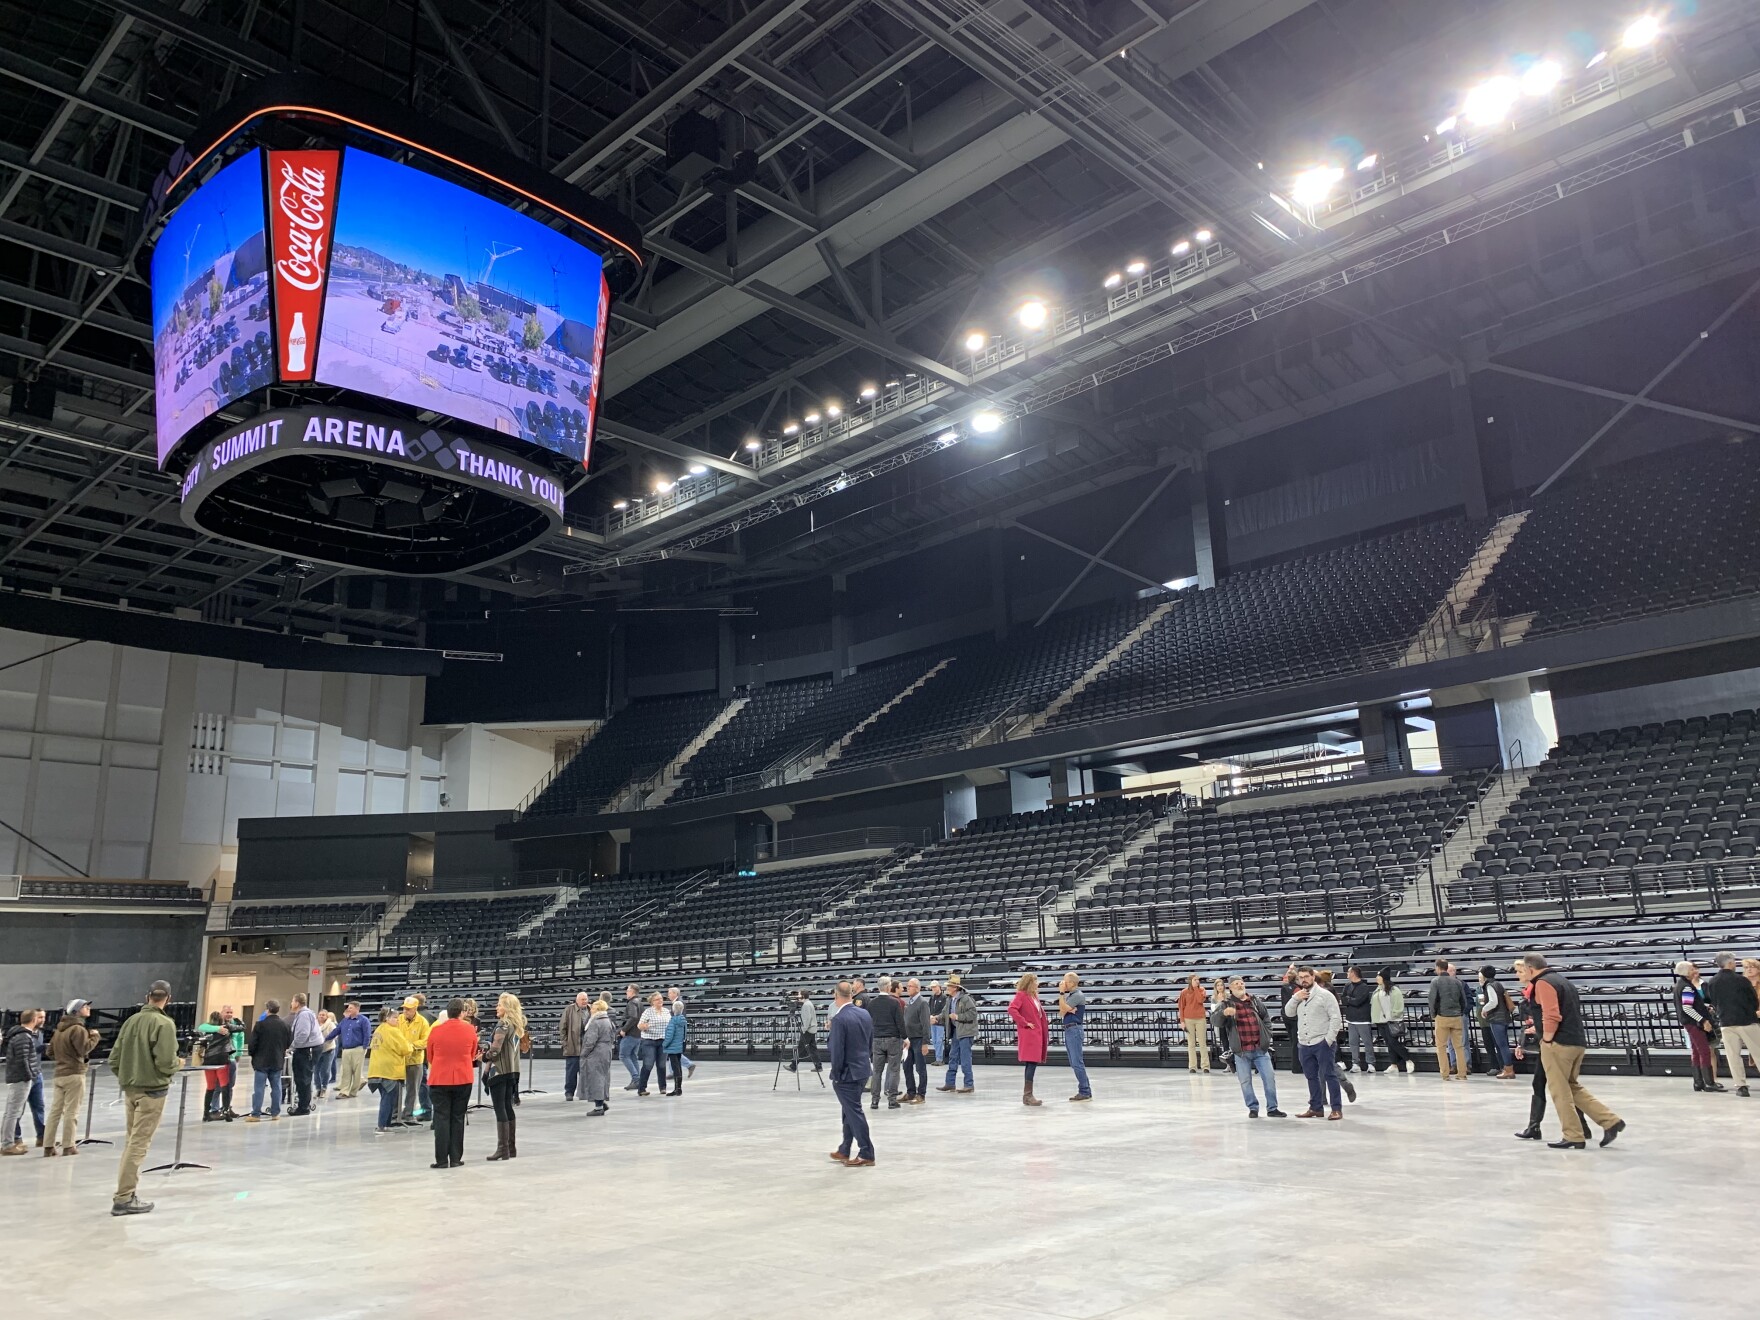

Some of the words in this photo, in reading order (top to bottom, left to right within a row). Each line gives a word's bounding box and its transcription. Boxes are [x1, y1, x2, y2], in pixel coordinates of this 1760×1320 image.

[278, 159, 325, 291] Coca-Cola
[212, 419, 283, 471] SUMMIT
[302, 416, 405, 456] ARENA
[456, 448, 523, 490] THANK
[528, 473, 558, 505] YOU
